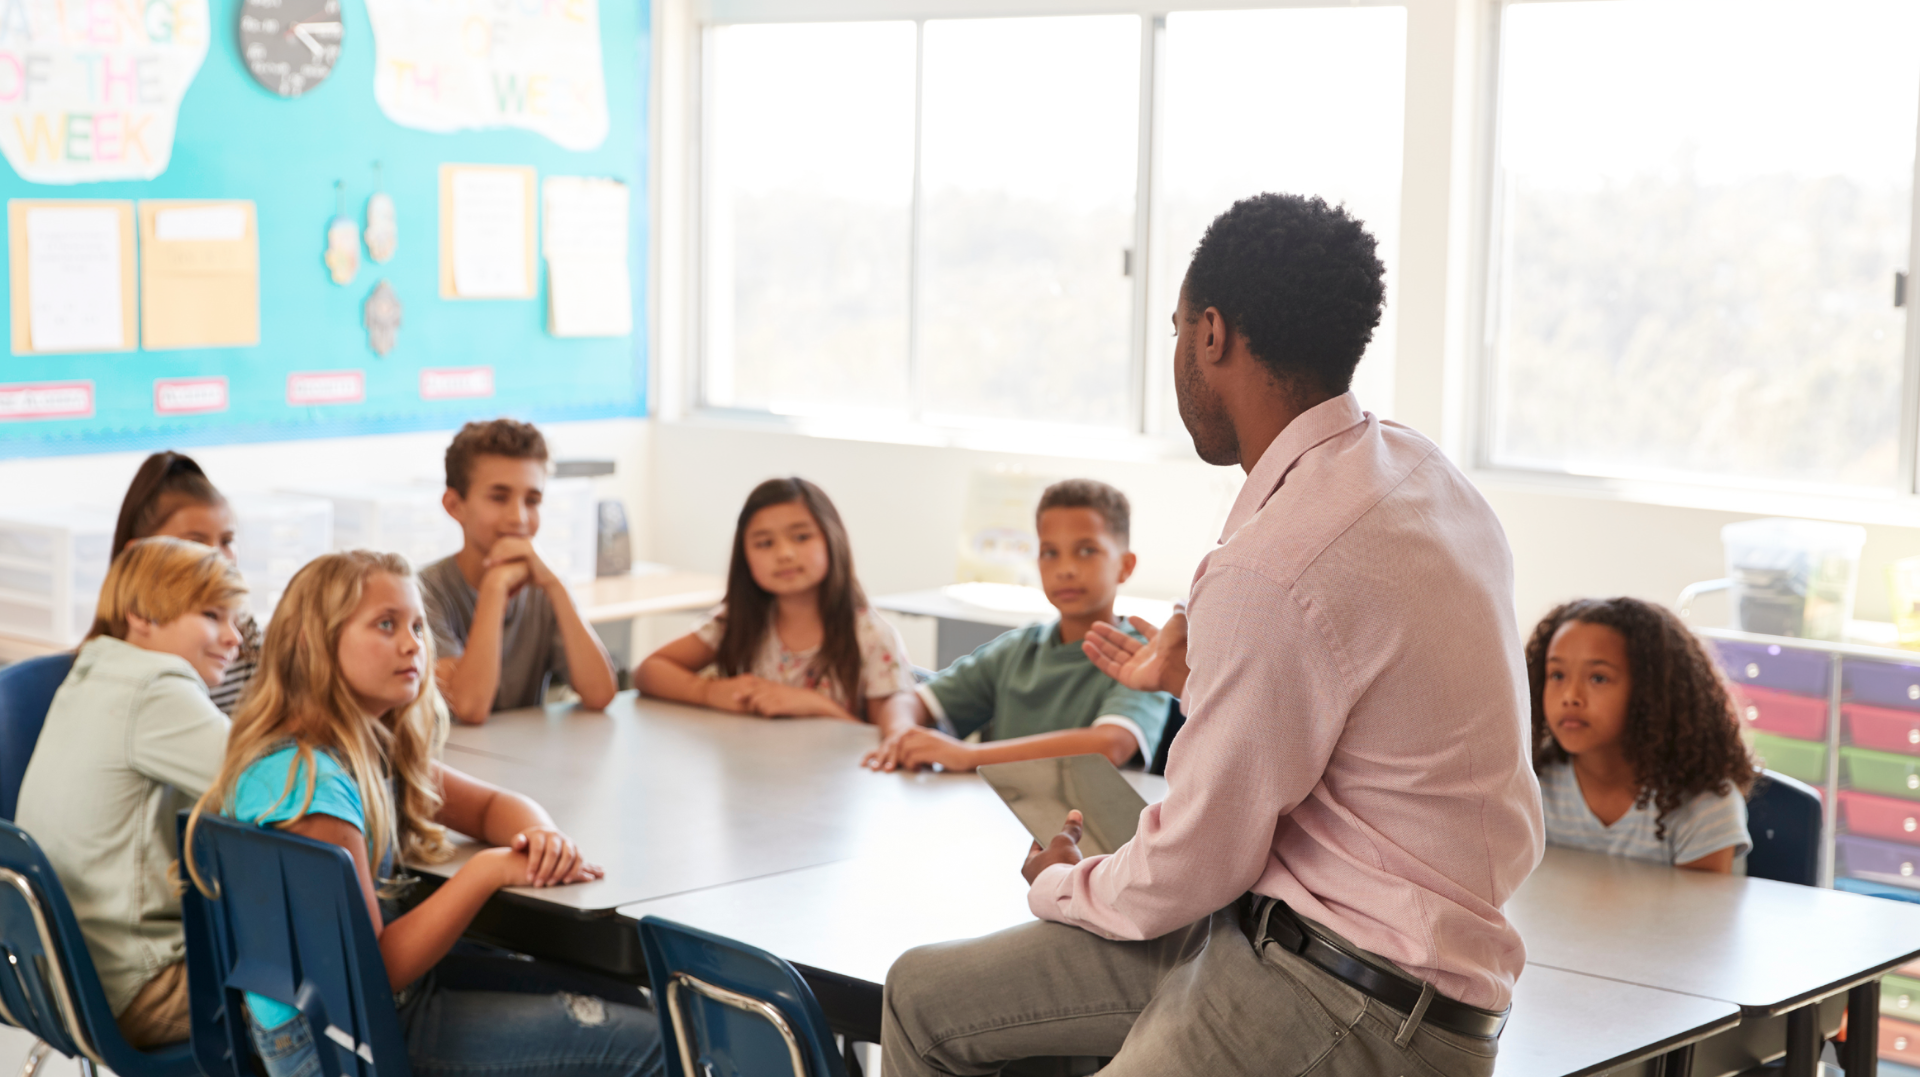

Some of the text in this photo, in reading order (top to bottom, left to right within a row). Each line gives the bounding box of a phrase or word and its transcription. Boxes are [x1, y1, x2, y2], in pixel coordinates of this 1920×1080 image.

[0, 51, 163, 104] OF THE
[13, 111, 154, 164] WEEK
